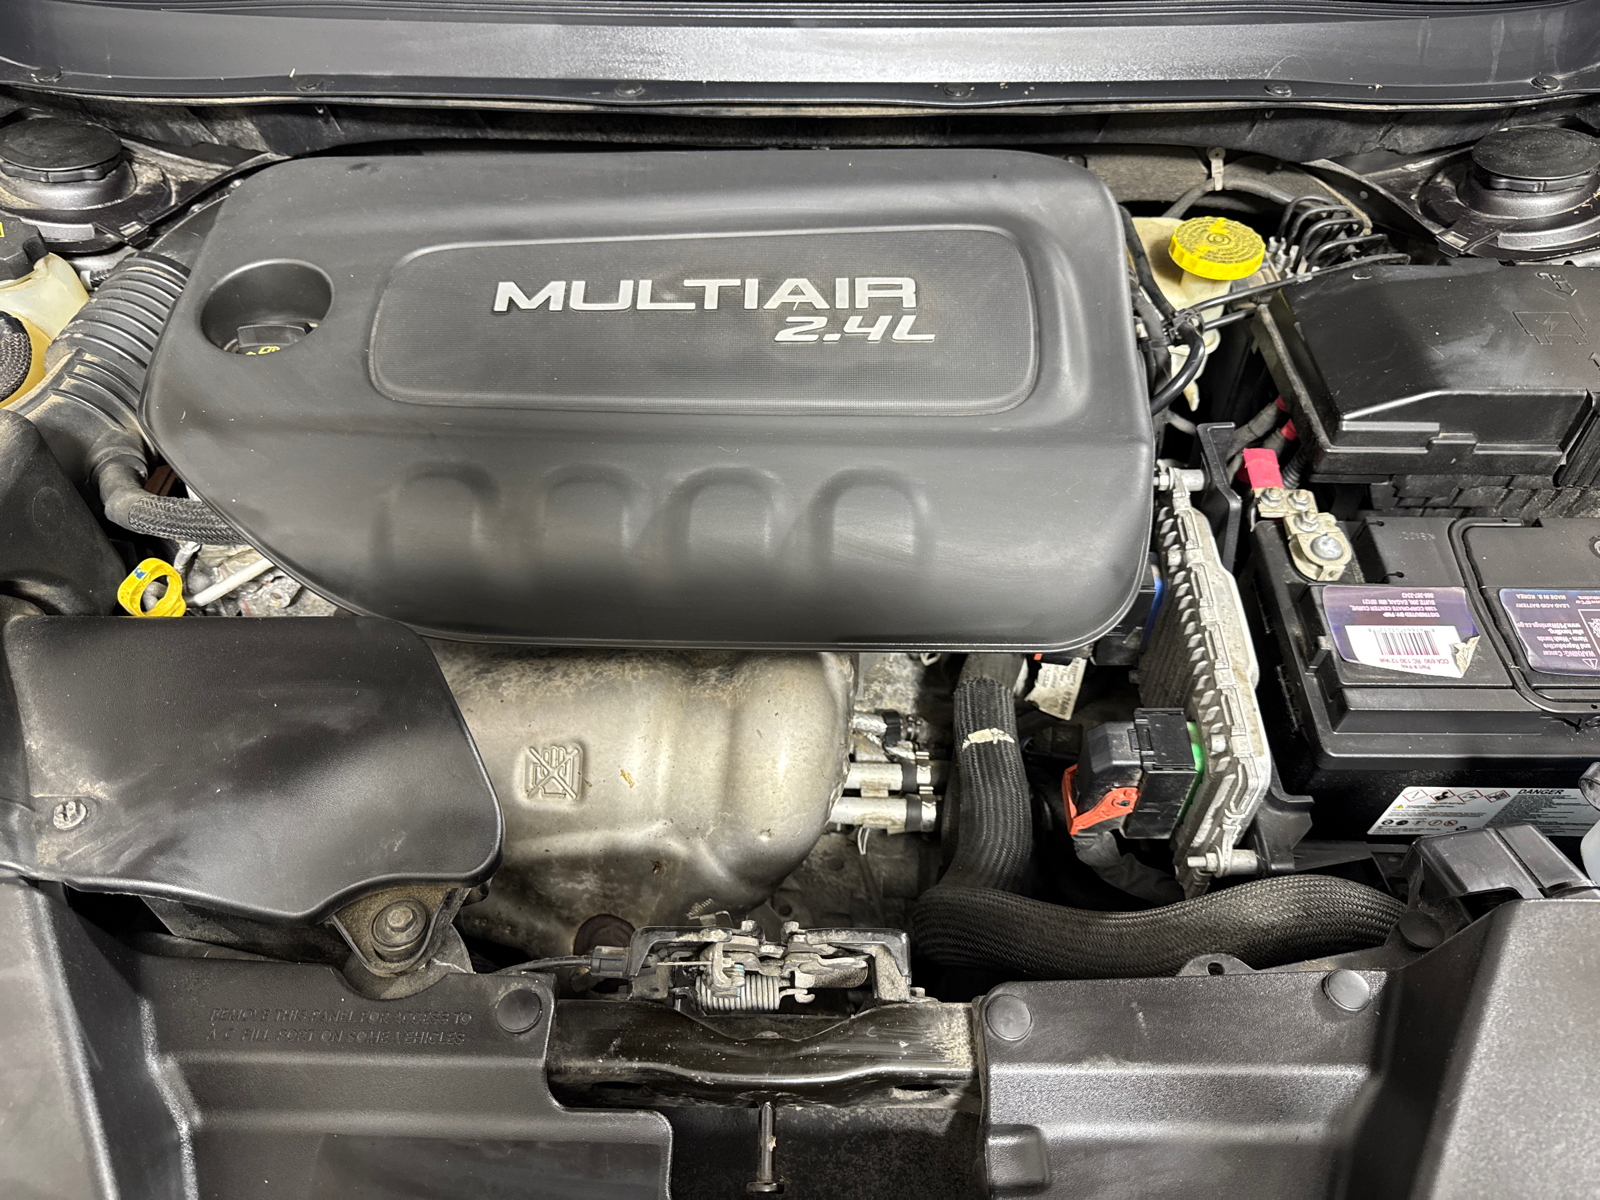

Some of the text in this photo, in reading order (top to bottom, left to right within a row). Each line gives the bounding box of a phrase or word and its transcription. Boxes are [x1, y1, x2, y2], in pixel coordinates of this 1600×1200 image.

[493, 277, 918, 312] MULTIAIR
[774, 314, 936, 342] 2.4L
[210, 1008, 472, 1026] REMOVE THIS PANEL FOR ACCESS TO
[242, 1028, 271, 1042] FILL
[277, 1029, 316, 1043] PORT
[320, 1029, 344, 1043] ON
[346, 1030, 390, 1044] SOME
[395, 1031, 466, 1045] VEHICLES
